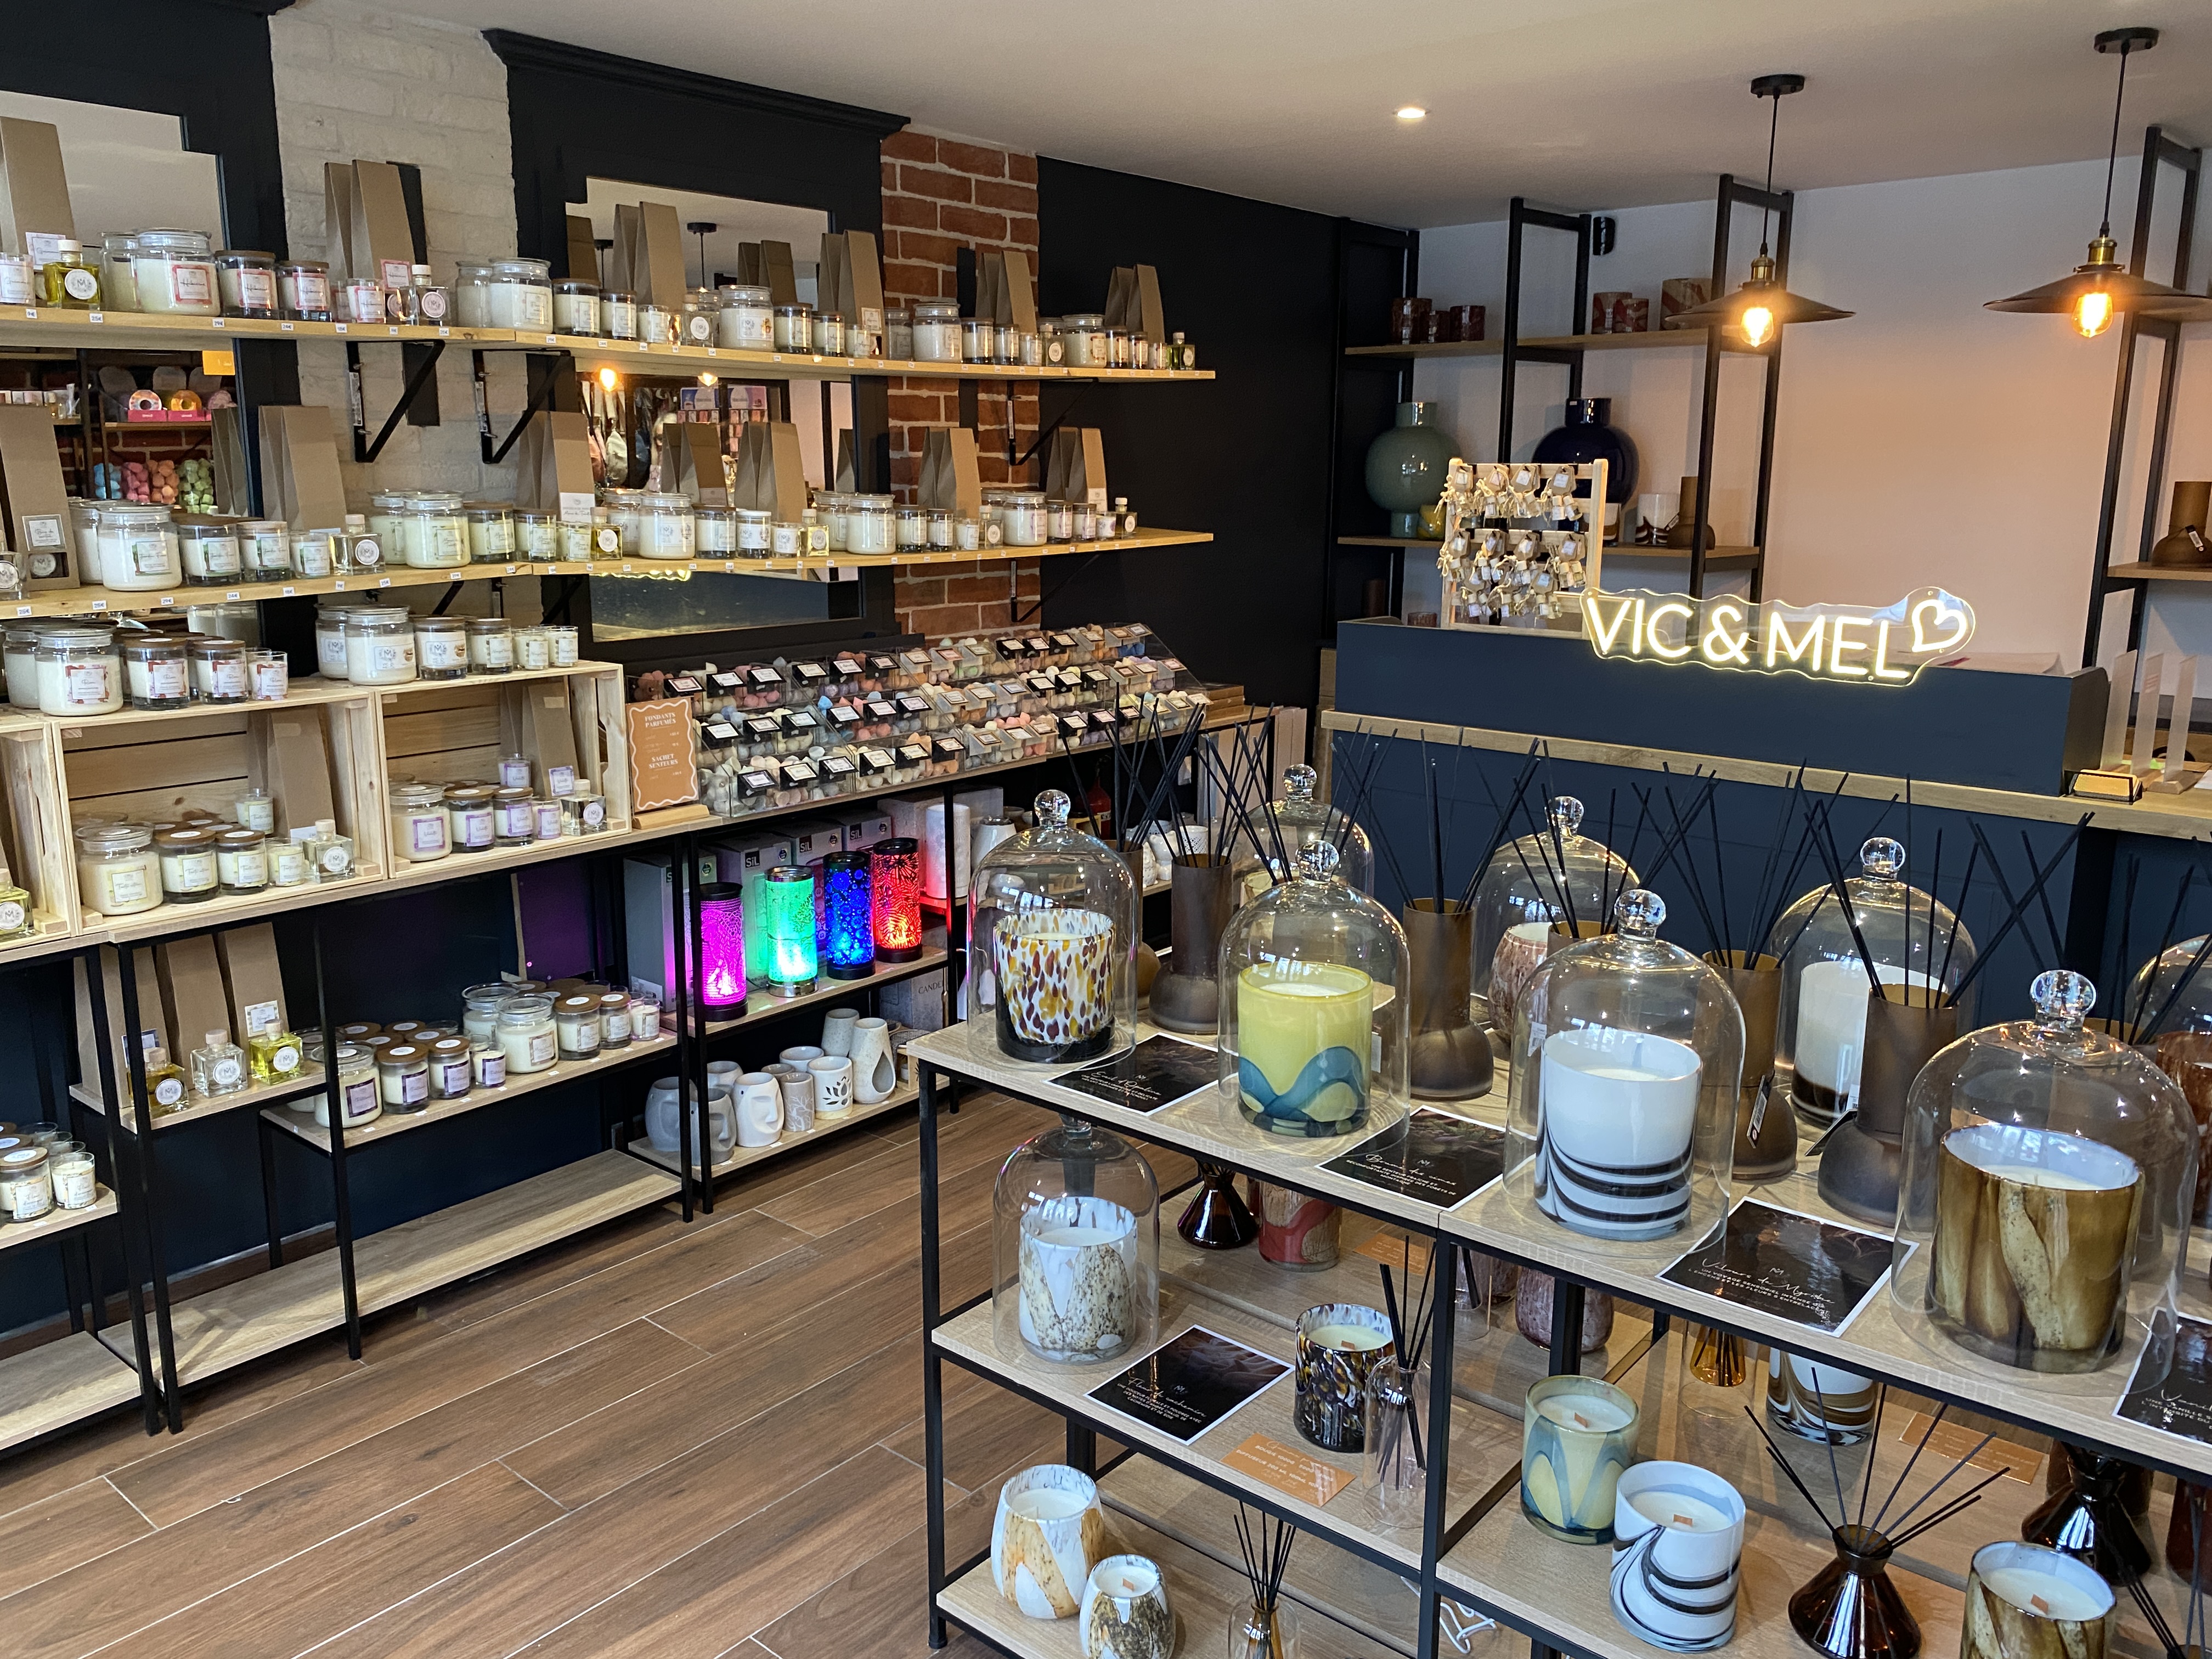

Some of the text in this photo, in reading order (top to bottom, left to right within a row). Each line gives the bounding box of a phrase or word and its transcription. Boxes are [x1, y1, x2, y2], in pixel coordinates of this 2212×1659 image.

[1587, 597, 1911, 679] VIC & MEL
[645, 713, 676, 721] FONDANTS
[645, 718, 676, 728] PARFUMÉS
[651, 753, 674, 762] SACHET
[649, 759, 678, 769] SENTEURS
[1381, 1167, 1406, 1176] SENTEUR
[1379, 1175, 1410, 1184] MONTAGNE
[1702, 1258, 1750, 1279] Velours
[1758, 1273, 1775, 1285] de
[1712, 1272, 1741, 1282] VOYAGE
[1742, 1281, 1779, 1294] SENSORIEL
[1781, 1293, 1811, 1304] INTENSE
[1745, 1286, 1771, 1296] FLEURS
[1125, 1387, 1145, 1397] DOUCEUR
[1126, 1397, 1150, 1408] CACHEMIRE
[1255, 1445, 1276, 1456] BOUGIE
[1236, 1449, 1266, 1464] DIFFUSEUR
